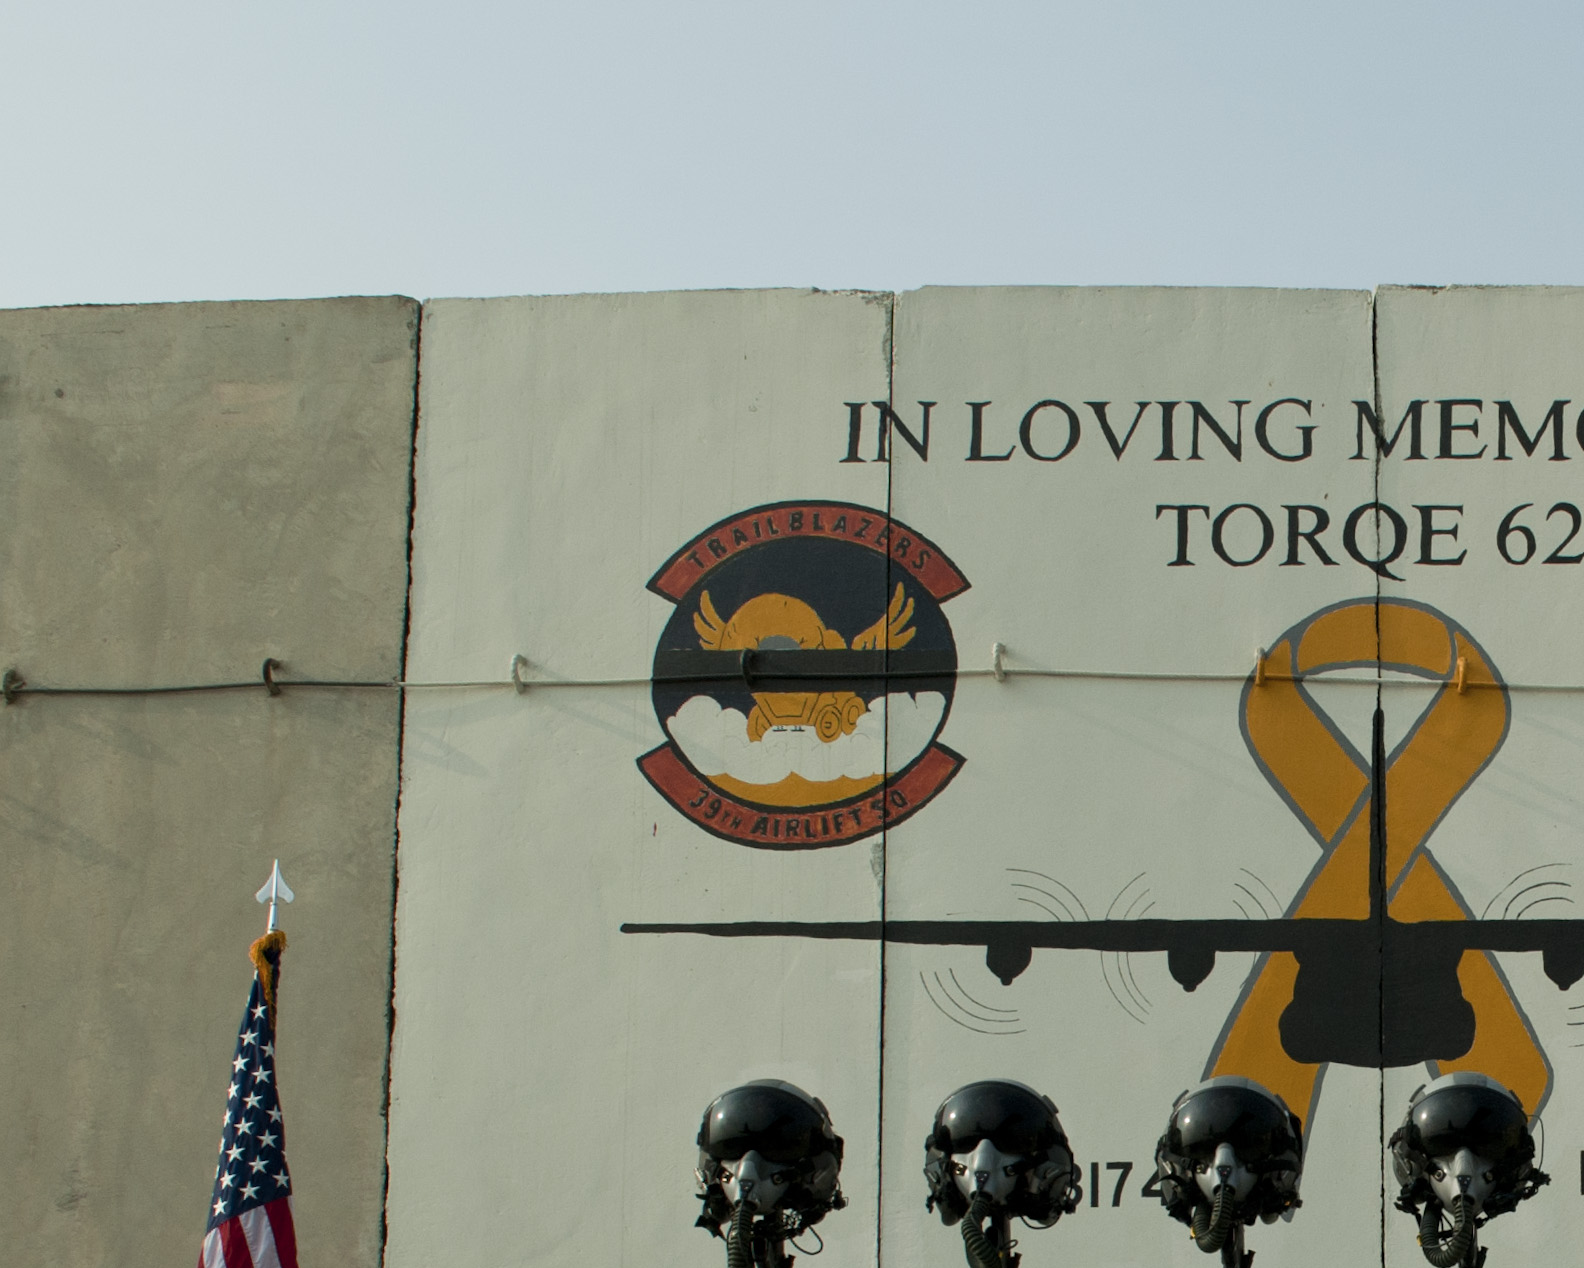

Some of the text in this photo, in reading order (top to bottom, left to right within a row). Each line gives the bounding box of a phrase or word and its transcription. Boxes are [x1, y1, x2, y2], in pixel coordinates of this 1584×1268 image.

[839, 400, 937, 463] IN
[965, 398, 1320, 462] LOVING
[1156, 501, 1468, 581] TORQE
[689, 788, 909, 839] 39TH AIRLIFT SQ
